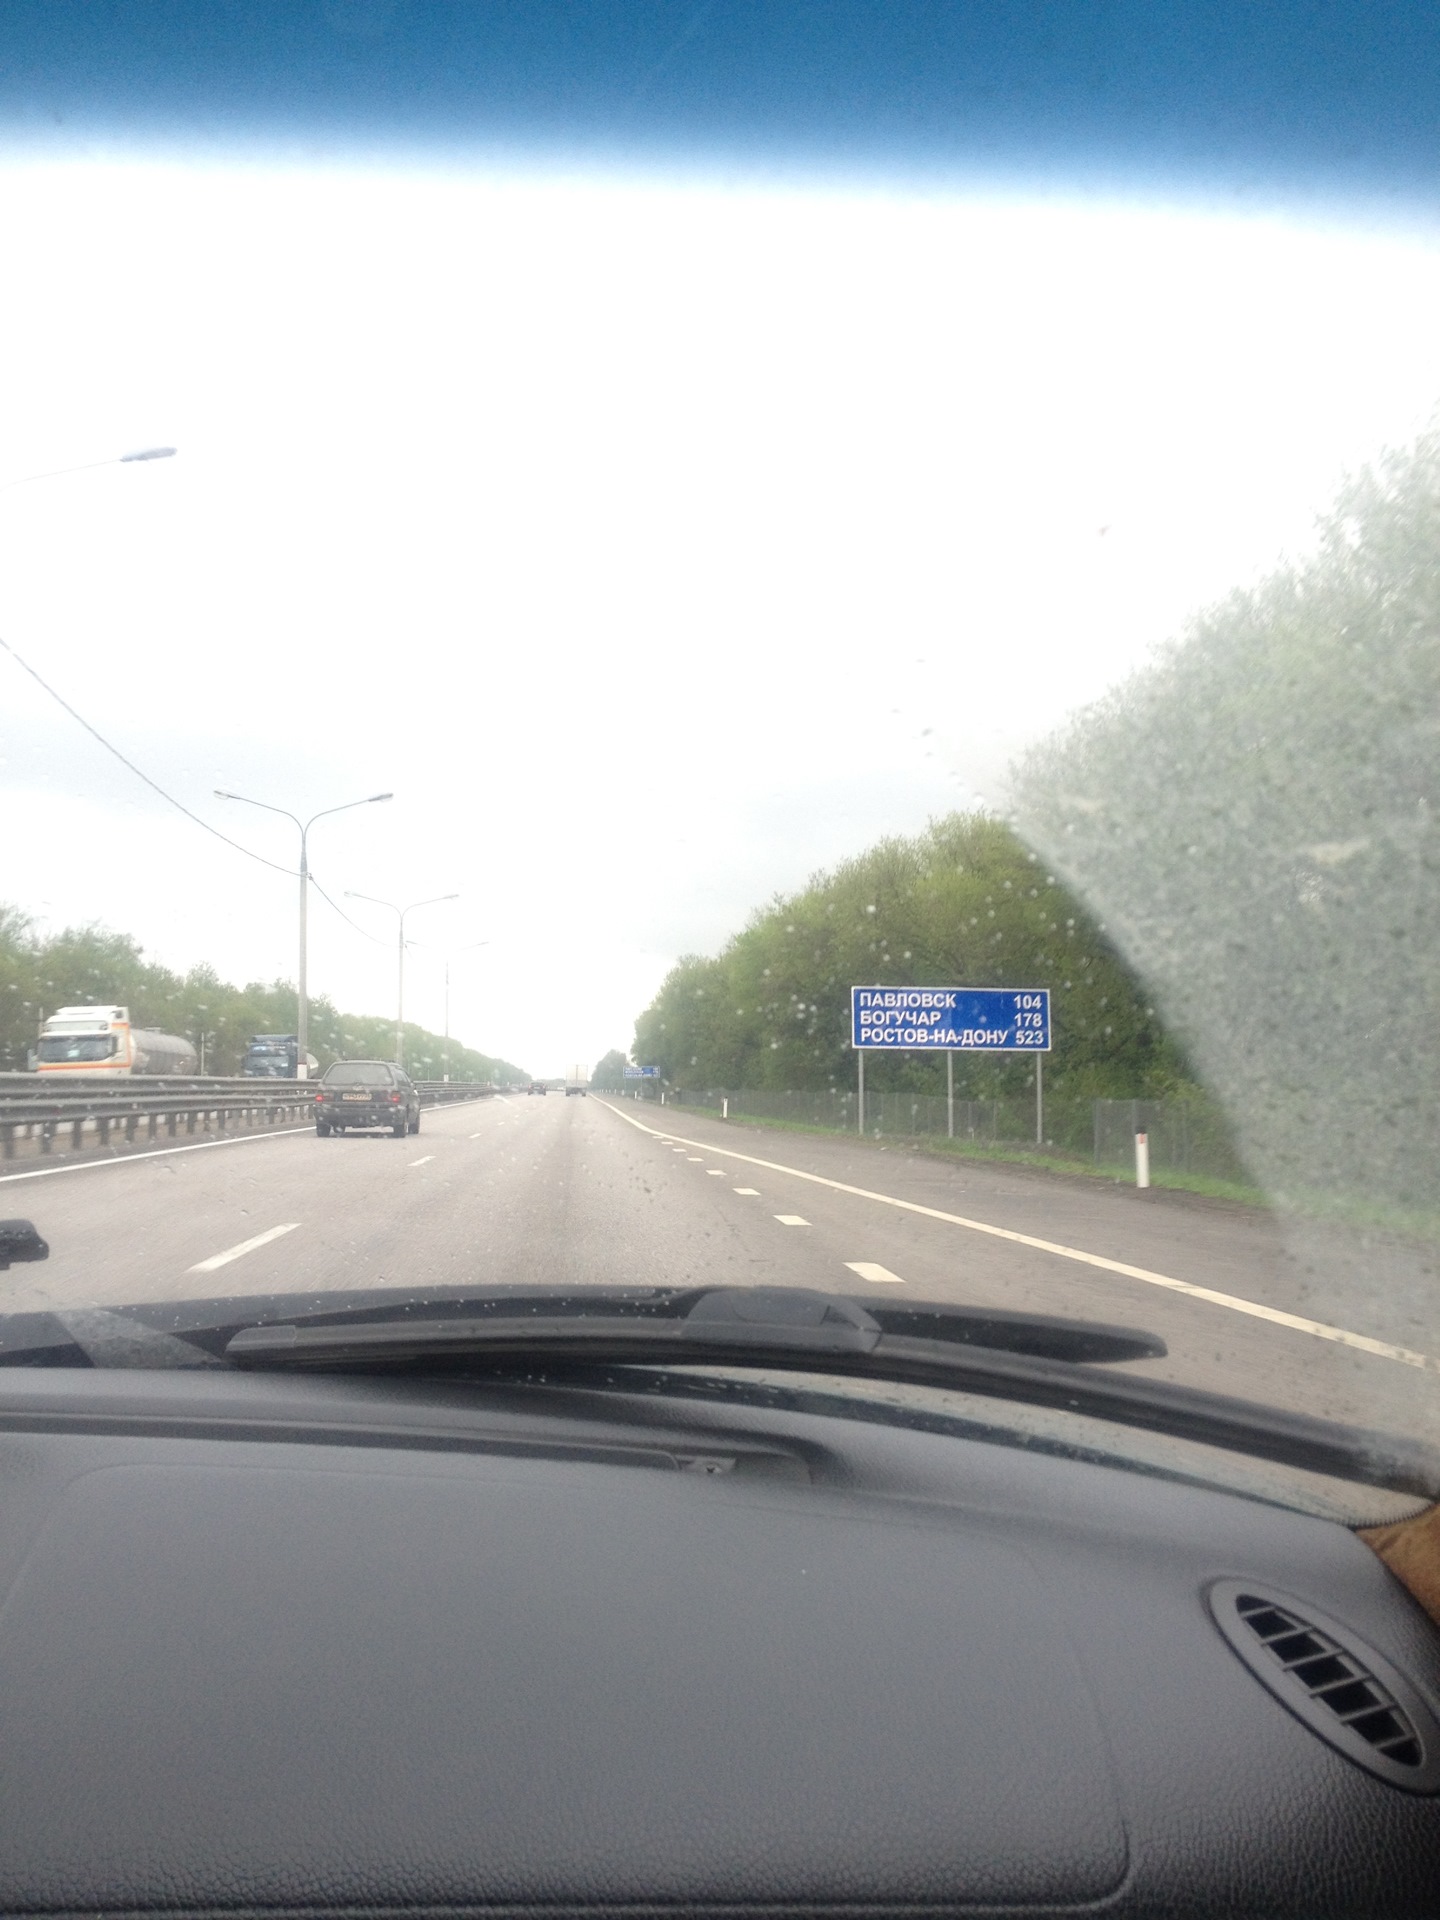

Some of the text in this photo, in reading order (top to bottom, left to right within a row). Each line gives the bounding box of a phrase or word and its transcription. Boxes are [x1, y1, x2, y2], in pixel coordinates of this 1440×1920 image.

[860, 992, 1042, 1009] ПАВЛОВСК 104
[860, 1010, 1042, 1027] БОГУЧАР 178
[861, 1028, 1044, 1046] РОСТОВ-НА-ДОНУ 523
